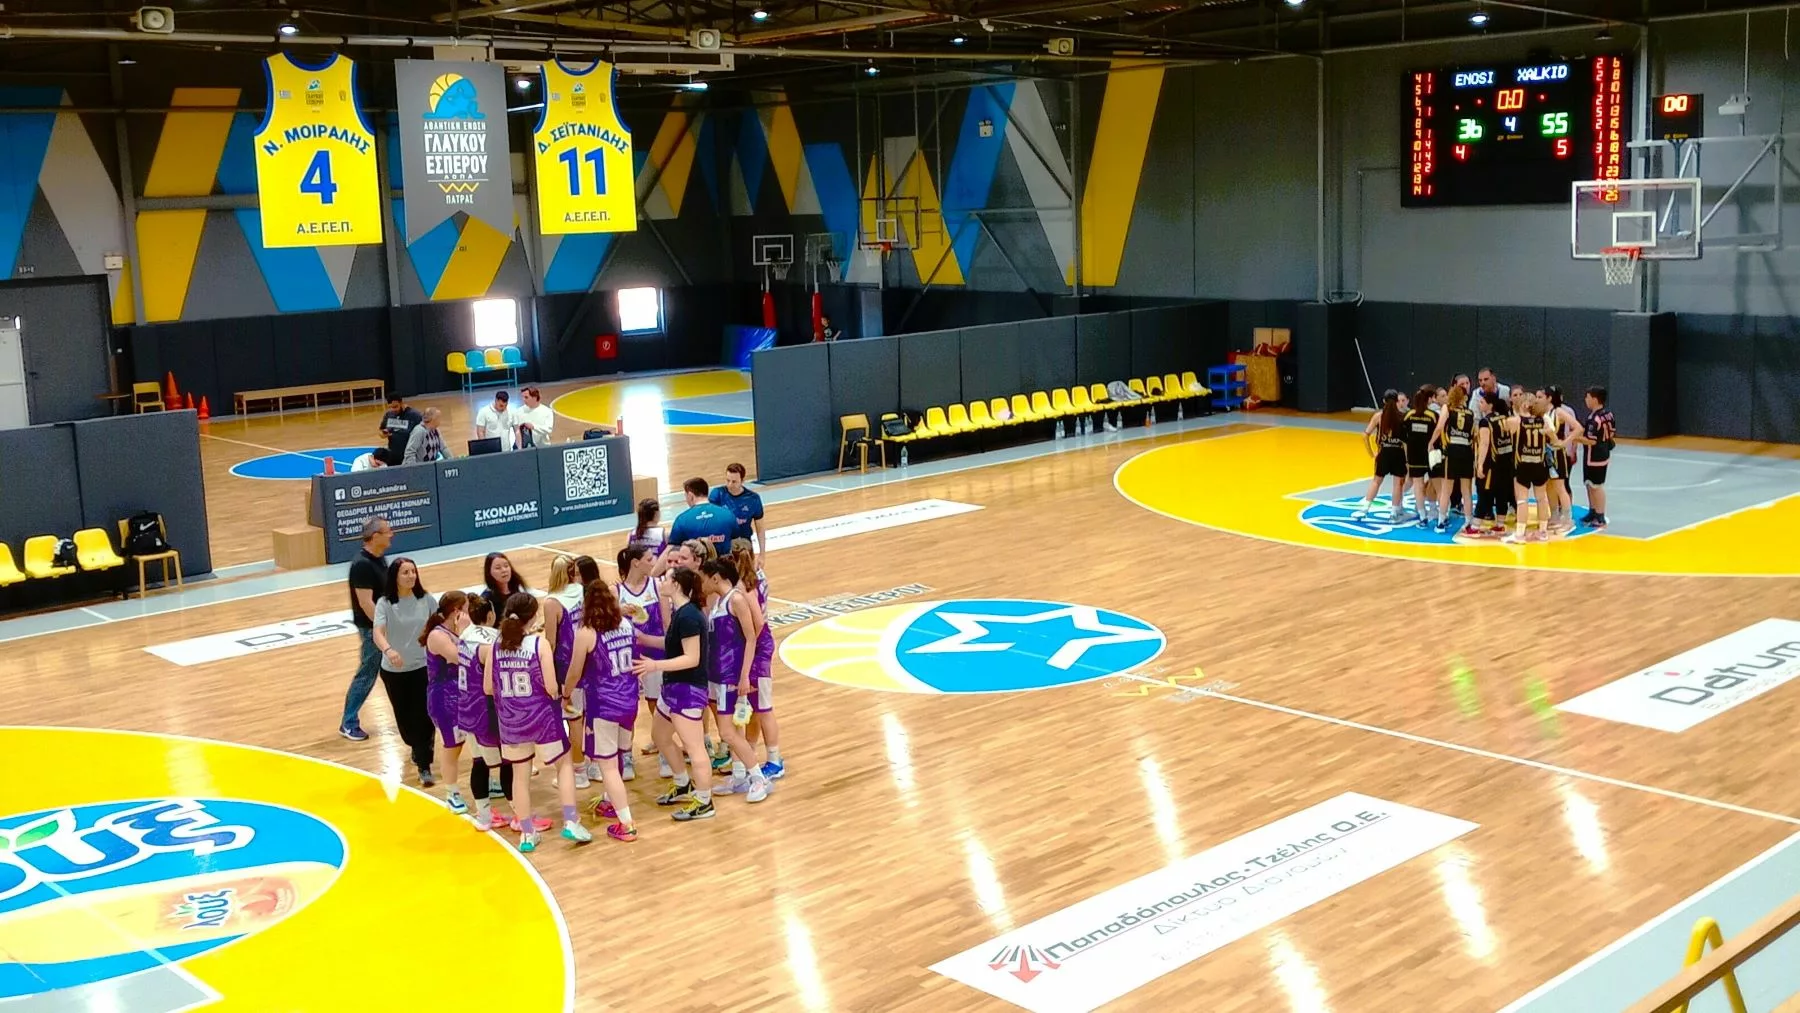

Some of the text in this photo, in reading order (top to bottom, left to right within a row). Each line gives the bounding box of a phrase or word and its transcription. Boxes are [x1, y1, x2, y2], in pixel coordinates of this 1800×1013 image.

[1596, 57, 1604, 69] 2
[1455, 72, 1494, 86] ENOSI
[1517, 65, 1568, 82] XALKID
[1596, 69, 1621, 81] 2 8
[1415, 85, 1421, 95] 5
[1596, 94, 1620, 105] 2 11
[1664, 95, 1688, 112] 00
[1596, 107, 1603, 117] 5
[1415, 118, 1421, 128] 8
[1459, 118, 1483, 139] 36
[1505, 116, 1517, 132] 4
[1542, 112, 1569, 134] 55
[1595, 119, 1603, 129] 2
[263, 124, 371, 156] Ν. ΜΟΙΡΑΛΗΣ
[424, 133, 486, 153] ΓΛΑΥΚΟΥ
[537, 122, 629, 154] Δ. ΣΕΪΤΑΝΙΔΗΣ
[1455, 145, 1465, 159] 4
[1557, 139, 1568, 155] 5
[425, 155, 488, 174] ΕΣΠΕΡΟΥ
[1413, 152, 1421, 161] 11
[300, 150, 337, 204] 4
[559, 147, 606, 196] 11
[1606, 166, 1619, 177] 23
[446, 195, 474, 204] ΠΑΤΡΑΣ
[564, 211, 610, 223] Α.Ε.Γ.Ε.Π.
[296, 221, 353, 234] Α.Ε.Γ.Ε.Π.
[1456, 412, 1466, 430] 5
[1526, 429, 1539, 448] 11
[444, 468, 459, 478] 1971
[474, 500, 539, 521] ΣΚΟΝΔΡΑΣ
[609, 647, 633, 677] 10
[500, 671, 532, 698] 18
[1330, 809, 1388, 833] Ο.Ε.
